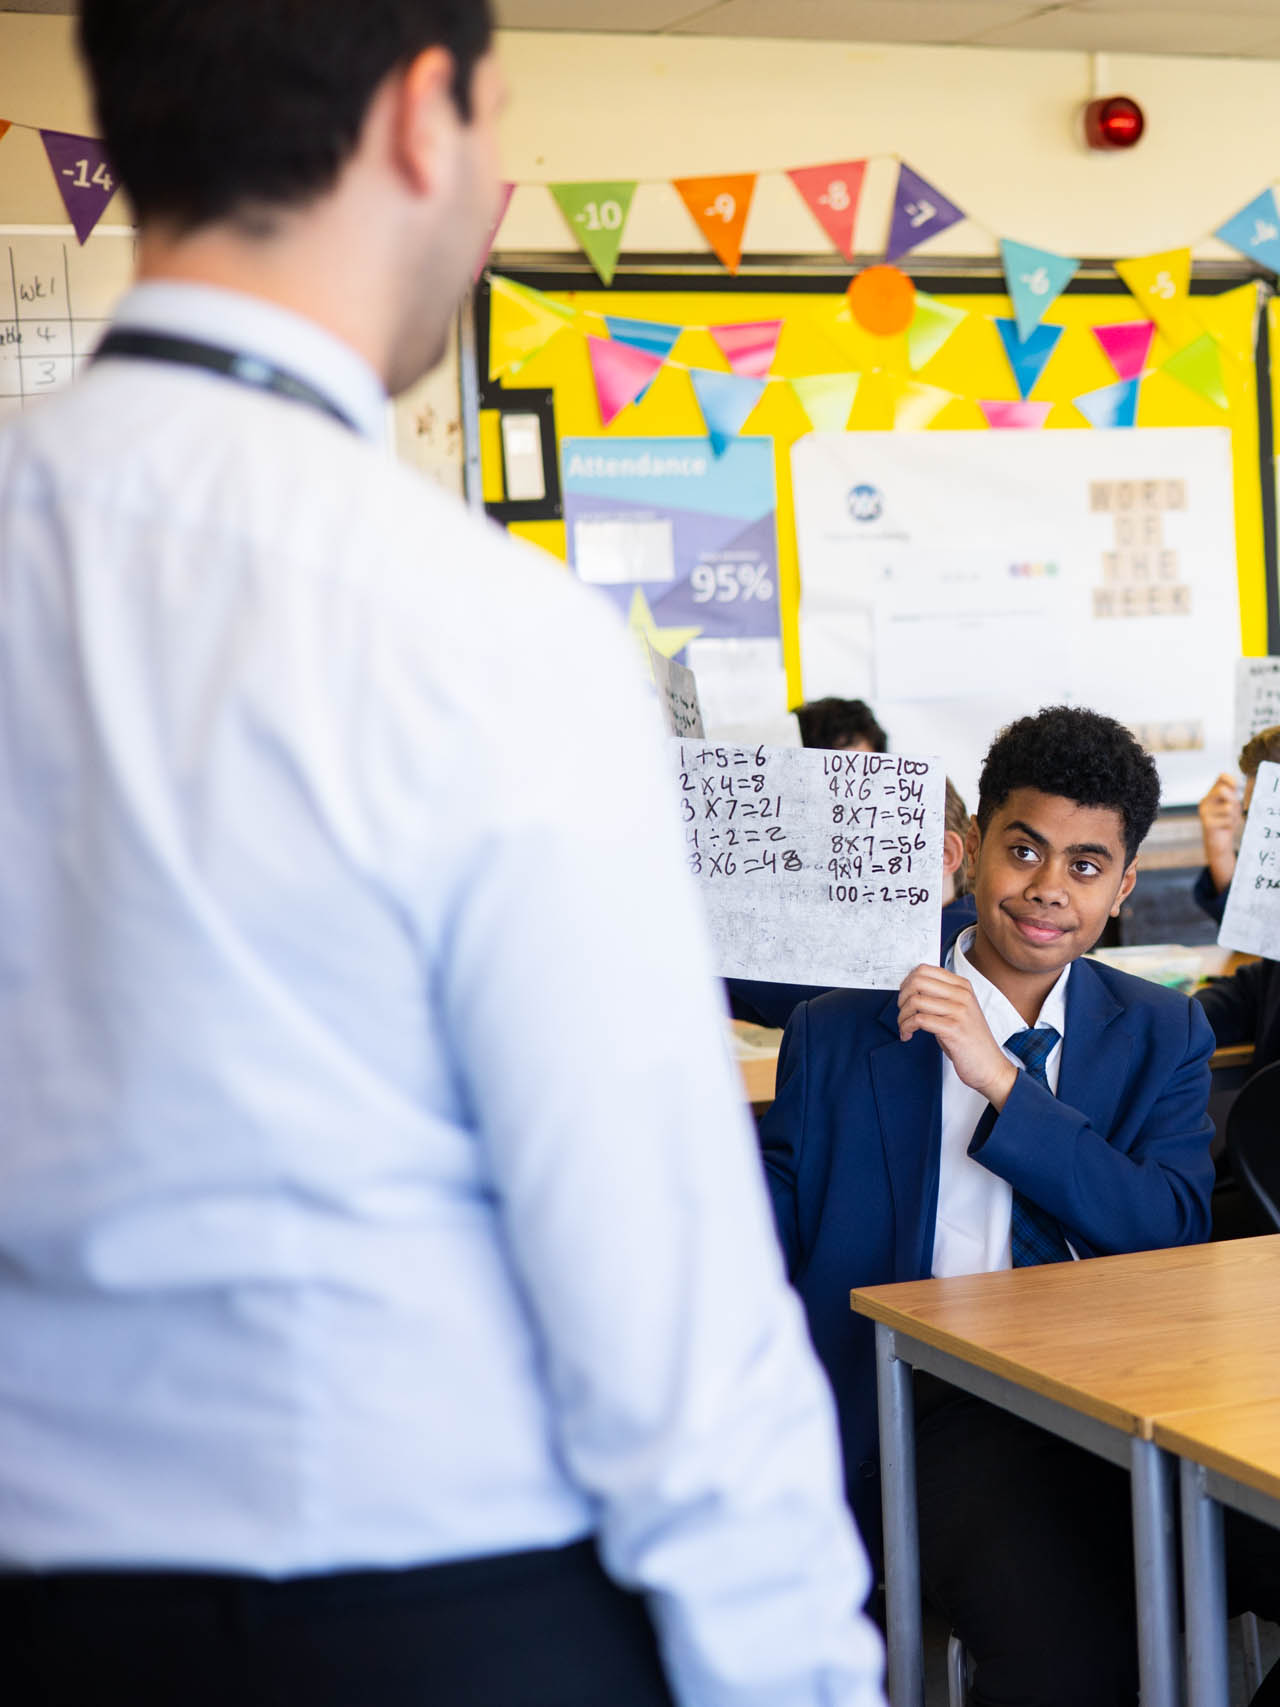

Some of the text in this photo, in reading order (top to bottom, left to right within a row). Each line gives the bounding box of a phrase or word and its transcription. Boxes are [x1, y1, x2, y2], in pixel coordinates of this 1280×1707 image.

[62, 159, 113, 191] -14
[705, 194, 736, 223] -9
[819, 180, 850, 210] -8
[574, 201, 622, 230] -10
[1019, 267, 1050, 296] -6
[567, 453, 707, 478] Attendance
[690, 562, 773, 603] 95%
